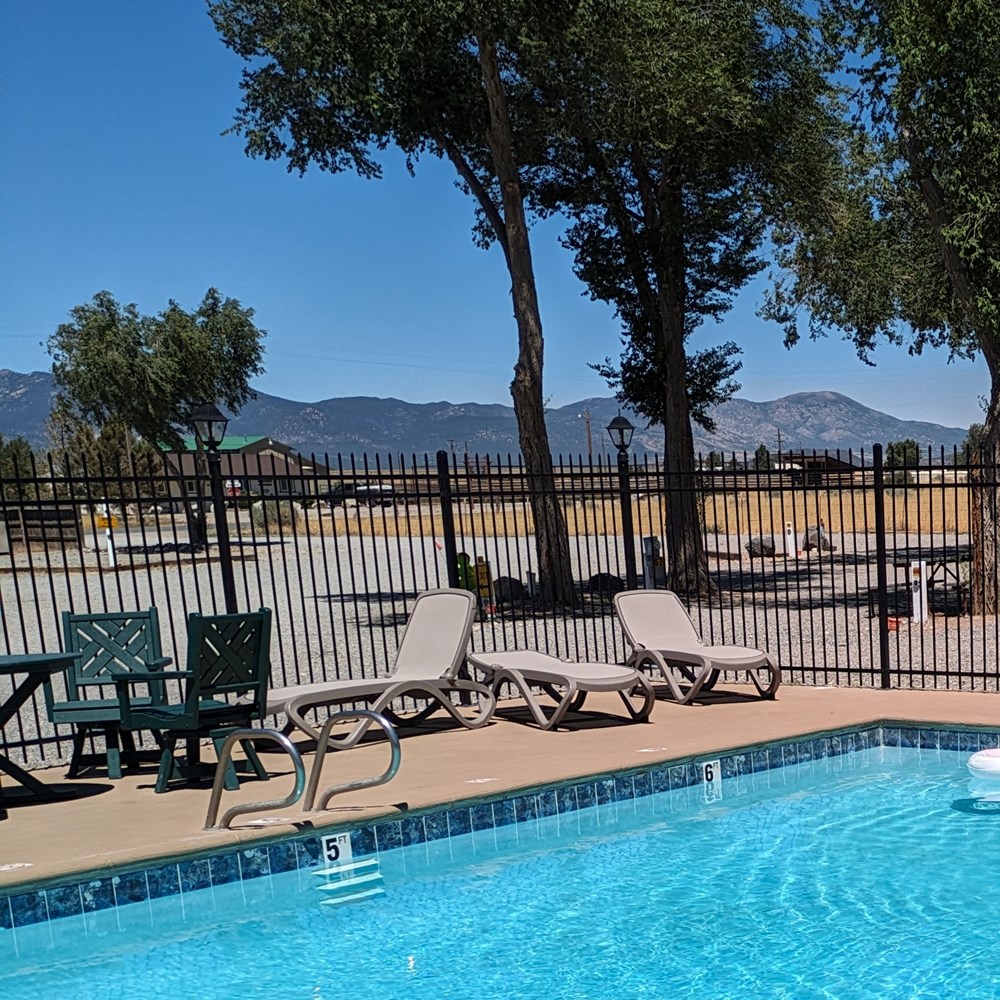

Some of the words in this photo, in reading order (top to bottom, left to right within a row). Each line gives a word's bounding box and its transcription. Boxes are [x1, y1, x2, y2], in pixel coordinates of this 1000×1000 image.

[704, 764, 714, 782] 6
[325, 837, 340, 862] 5
[338, 835, 347, 845] FT
